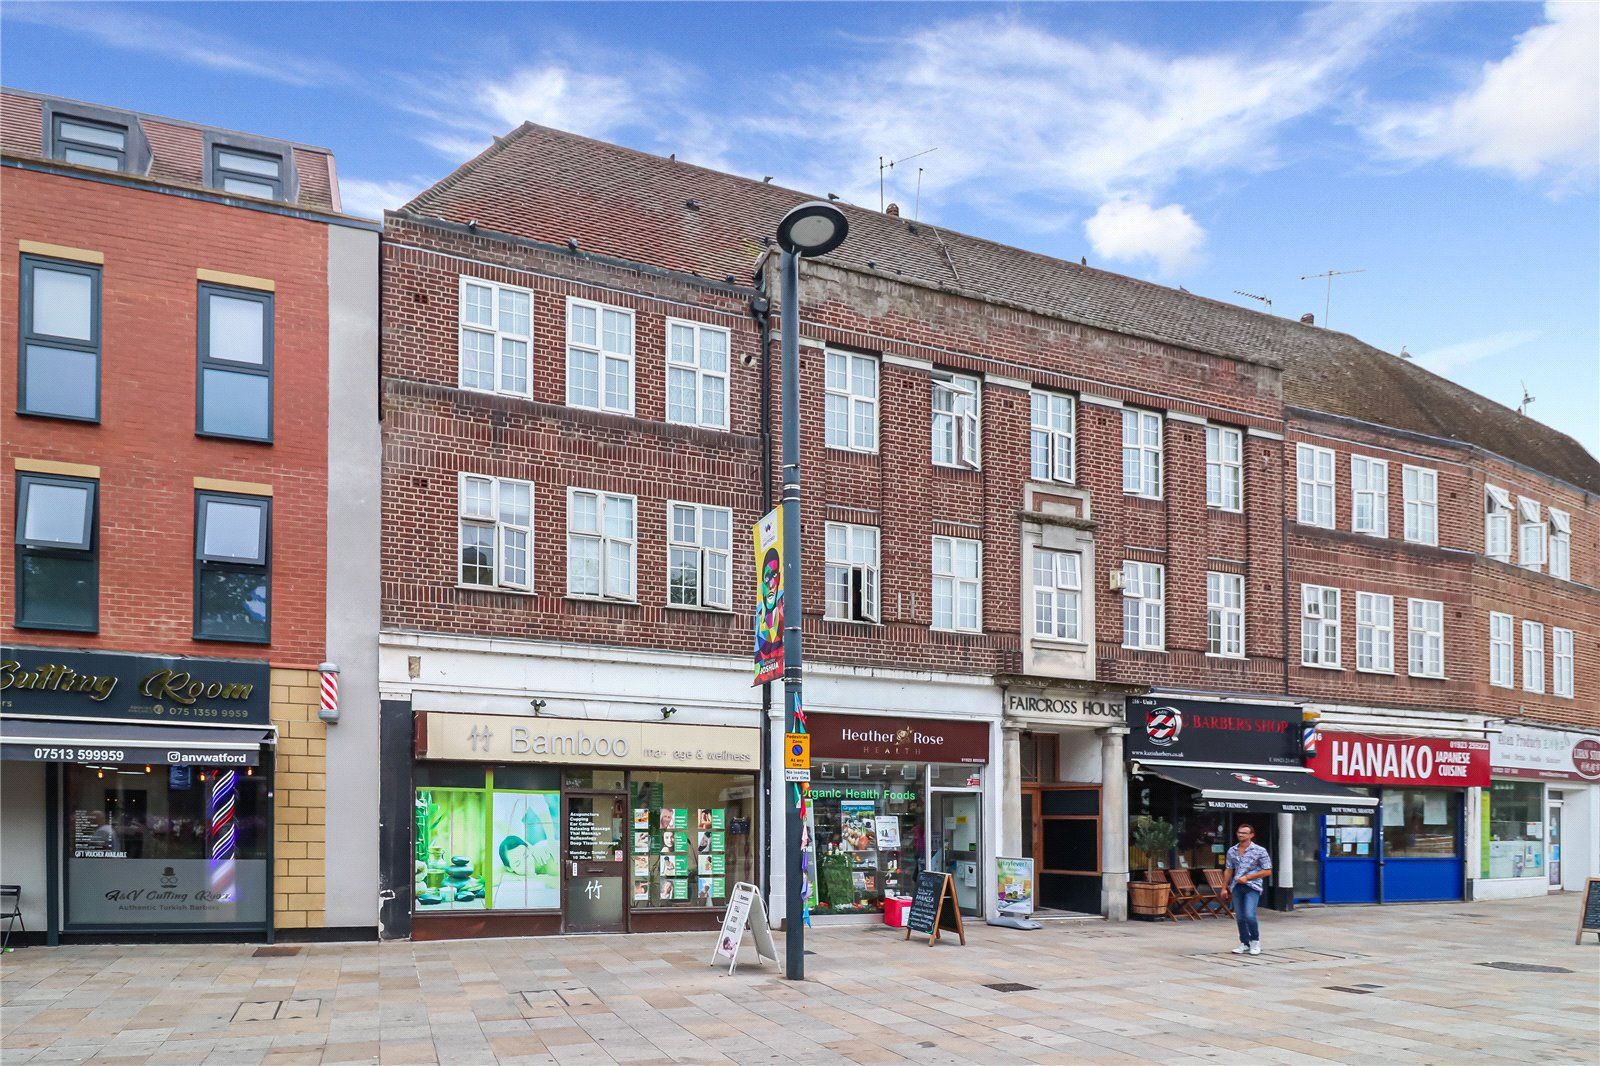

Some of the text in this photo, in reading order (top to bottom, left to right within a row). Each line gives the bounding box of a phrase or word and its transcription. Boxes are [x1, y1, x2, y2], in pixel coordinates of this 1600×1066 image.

[760, 661, 779, 675] JOSHUA
[139, 668, 254, 704] Room
[170, 707, 249, 718] 075 1359 9959
[1009, 696, 1124, 718] FAIRCROSS HOUSE
[1193, 715, 1252, 731] BARBERS
[1255, 719, 1289, 734] SHOP
[468, 724, 494, 752] 竹
[511, 725, 630, 757] Bamboo
[842, 728, 944, 745] Heather Rose
[34, 748, 125, 761] 07513 599959
[182, 752, 247, 763] anvwatford
[696, 750, 703, 760] &
[707, 750, 751, 762] wellness
[864, 746, 921, 755] HEALTH
[1332, 740, 1433, 779] HANAKO
[1435, 751, 1471, 765] JAPANESE
[1439, 764, 1468, 777] CUISINE
[845, 788, 880, 800] Health
[884, 790, 916, 800] Foods
[105, 889, 145, 902] A&V
[146, 890, 188, 903] Cutting
[585, 879, 603, 900] 竹
